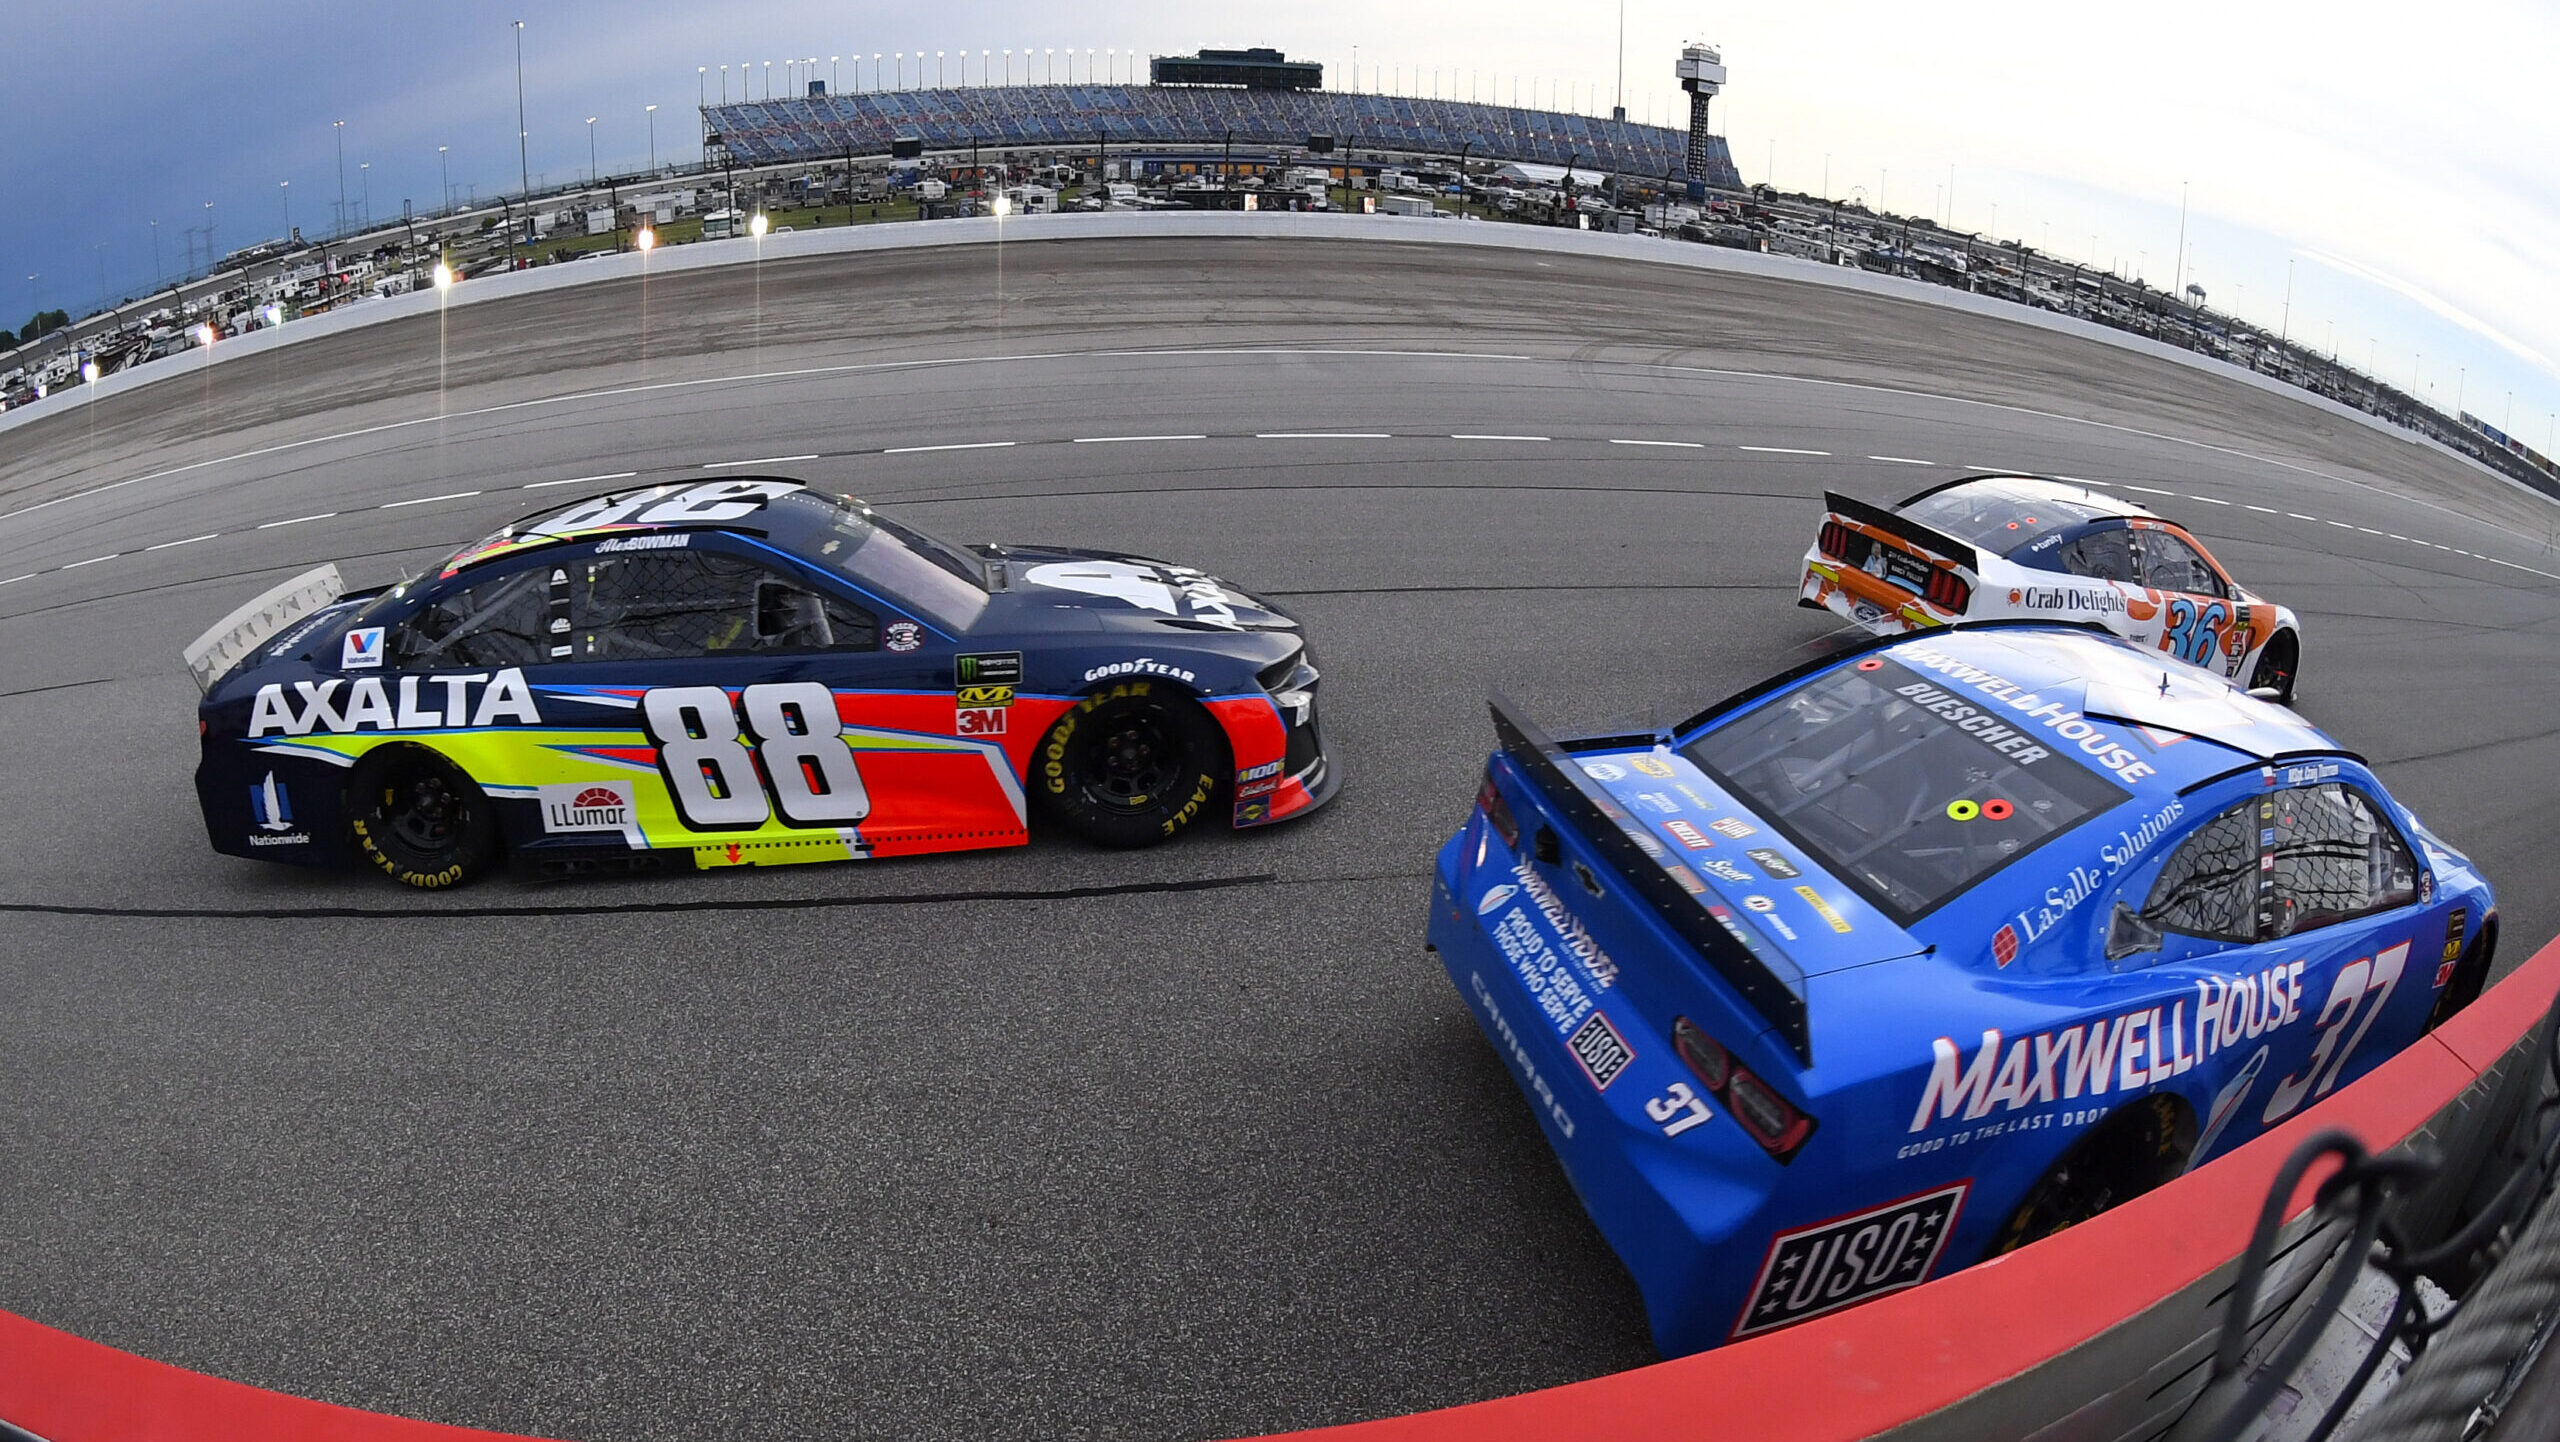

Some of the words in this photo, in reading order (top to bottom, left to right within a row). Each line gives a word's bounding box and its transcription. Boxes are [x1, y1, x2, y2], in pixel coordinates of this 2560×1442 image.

[630, 533, 691, 550] BOWMAN
[2038, 533, 2063, 550] tunity
[2026, 586, 2064, 610] Crab
[2068, 588, 2126, 617] Delights
[2168, 598, 2226, 669] 36
[247, 667, 543, 739] AXALTA
[958, 708, 1004, 734] 3M
[1891, 643, 2042, 711] MAXWELL
[2026, 702, 2157, 784] HOUSE
[1894, 682, 2051, 766] BUESCHER
[642, 682, 871, 829] 88
[248, 831, 311, 847] Nationwide
[550, 803, 628, 829] LLumar
[1161, 773, 1214, 837] EAGLE
[1704, 860, 1754, 881] Scott
[2015, 866, 2102, 945] LaSalle
[2100, 798, 2185, 876] Solutions
[1492, 920, 1526, 965] THOSE
[1518, 954, 1546, 993] WHO
[1536, 987, 1578, 1036] SERVE
[1505, 906, 1544, 955] PROUD
[1536, 946, 1558, 973] TO
[1549, 967, 1594, 1020] SERVE
[1471, 971, 1575, 1140] CAMARO
[1907, 1000, 2193, 1134] MAXWELL
[2195, 960, 2306, 1066] HOUSE
[2262, 938, 2412, 1127] 37
[1645, 1082, 1713, 1138] 37
[1896, 1136, 1945, 1160] GOOD
[1949, 1131, 1970, 1146] TO
[1974, 1121, 2004, 1141] THE
[2007, 1113, 2054, 1133] LAST
[1785, 1210, 1921, 1311] USO
